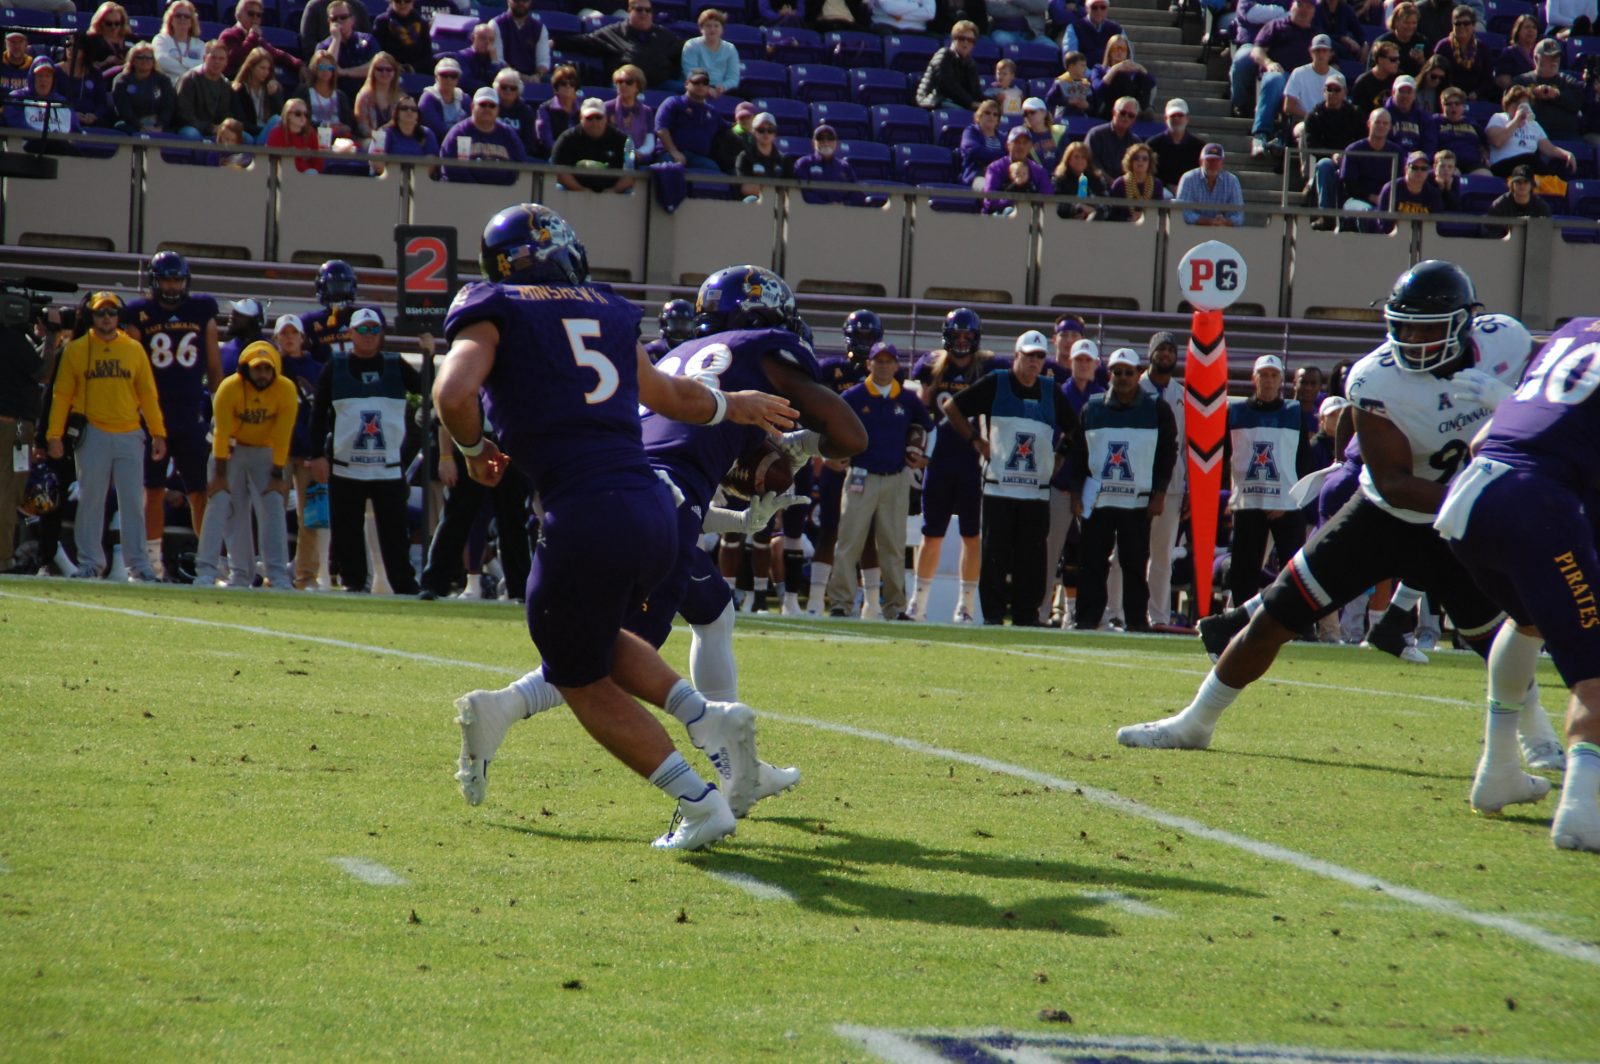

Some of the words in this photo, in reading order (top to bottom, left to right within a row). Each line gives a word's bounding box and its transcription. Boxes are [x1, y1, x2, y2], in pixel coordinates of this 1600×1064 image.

[405, 236, 448, 293] 2
[1189, 258, 1238, 291] P6
[94, 359, 121, 369] EAST
[150, 332, 198, 369] 86
[562, 318, 620, 405] 5
[1515, 336, 1600, 405] 10
[84, 367, 132, 380] CAROLINA
[353, 410, 387, 450] A
[350, 455, 387, 464] AMERICAN
[1005, 431, 1037, 472] A
[1101, 441, 1135, 481] A
[1245, 441, 1280, 481] A
[1002, 475, 1038, 486] AMERICAN
[1242, 486, 1281, 496] AMERICAN
[1553, 550, 1600, 629] PIRATES
